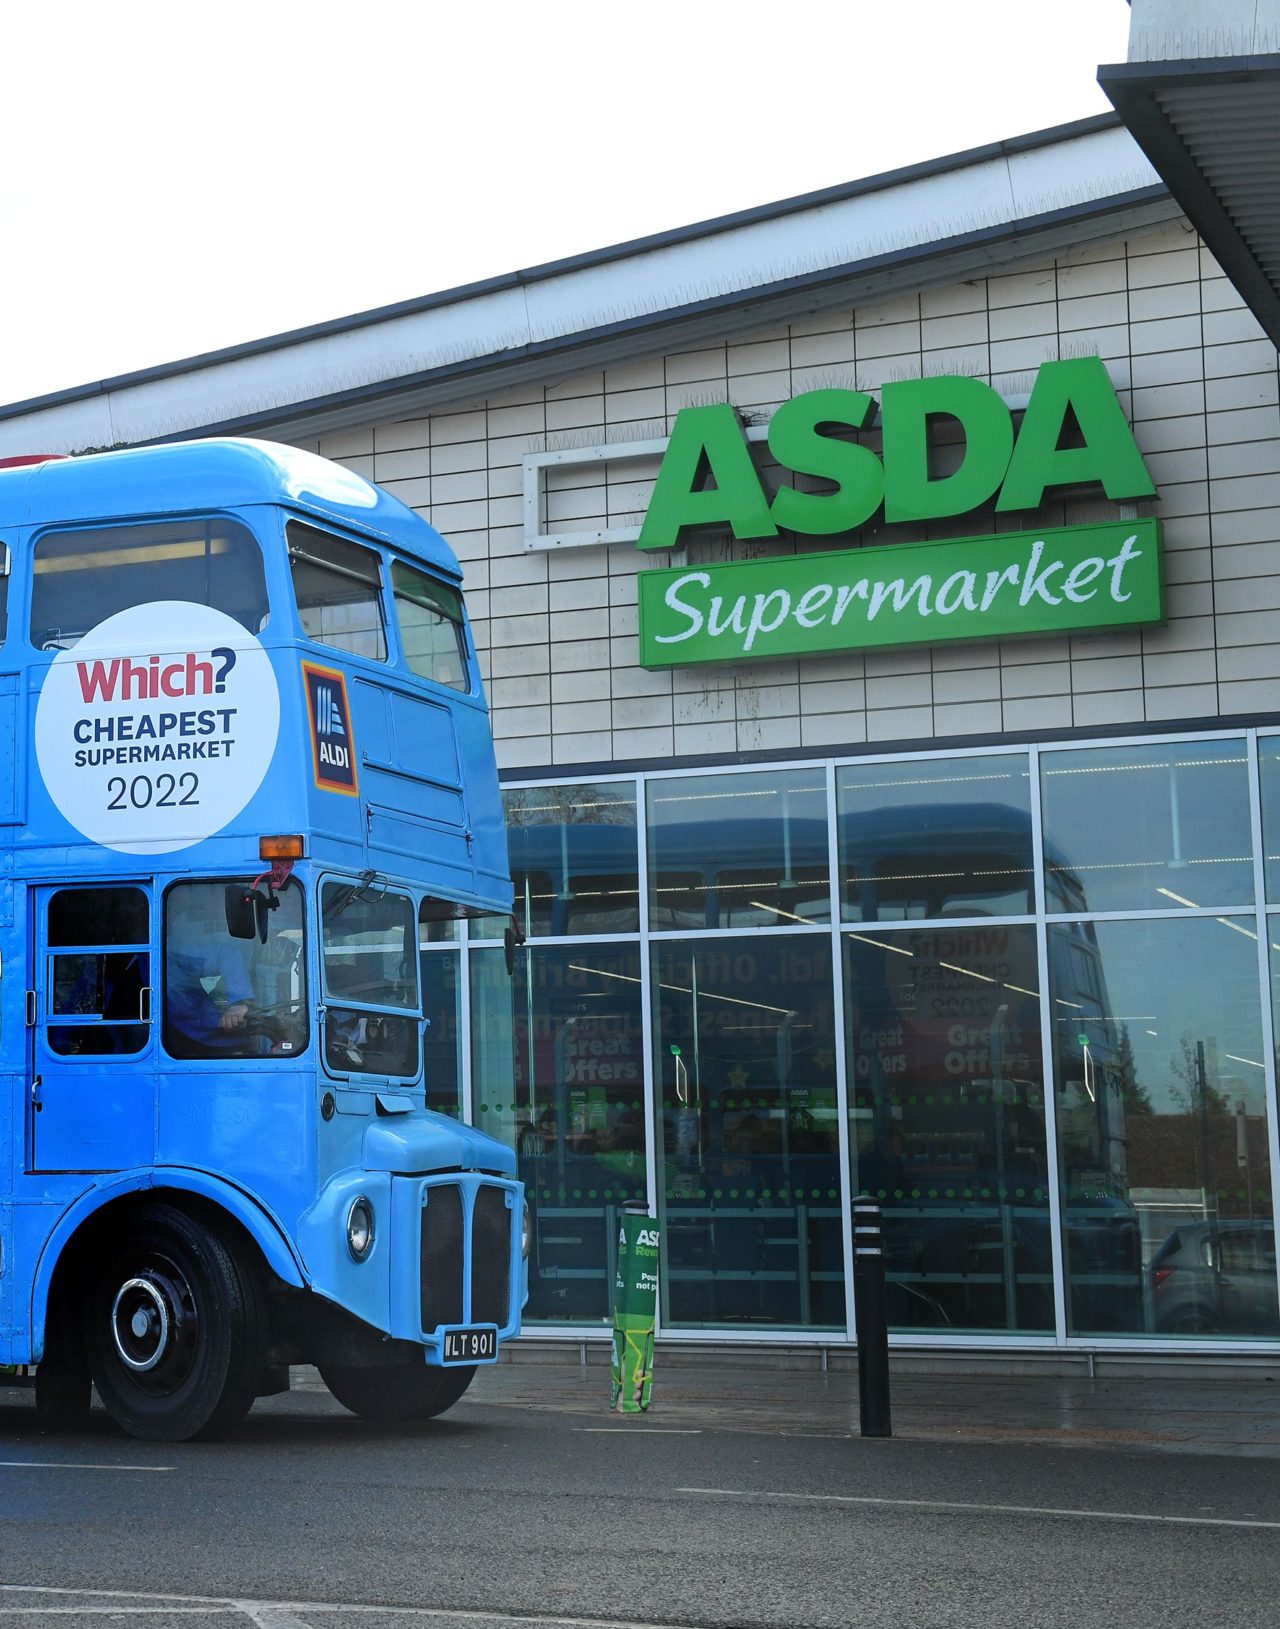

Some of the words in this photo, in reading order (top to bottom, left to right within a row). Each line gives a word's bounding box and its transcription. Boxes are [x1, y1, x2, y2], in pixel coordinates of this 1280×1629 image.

[636, 356, 1157, 552] ASDA
[655, 535, 1143, 651] Supermarket
[77, 647, 237, 704] Which?
[73, 708, 238, 743] CHEAPEST
[74, 739, 235, 767] SUPERMARKET
[319, 742, 349, 769] ALDI
[106, 772, 200, 811] 2022
[636, 1282, 650, 1290] not
[471, 1333, 493, 1355] 901
